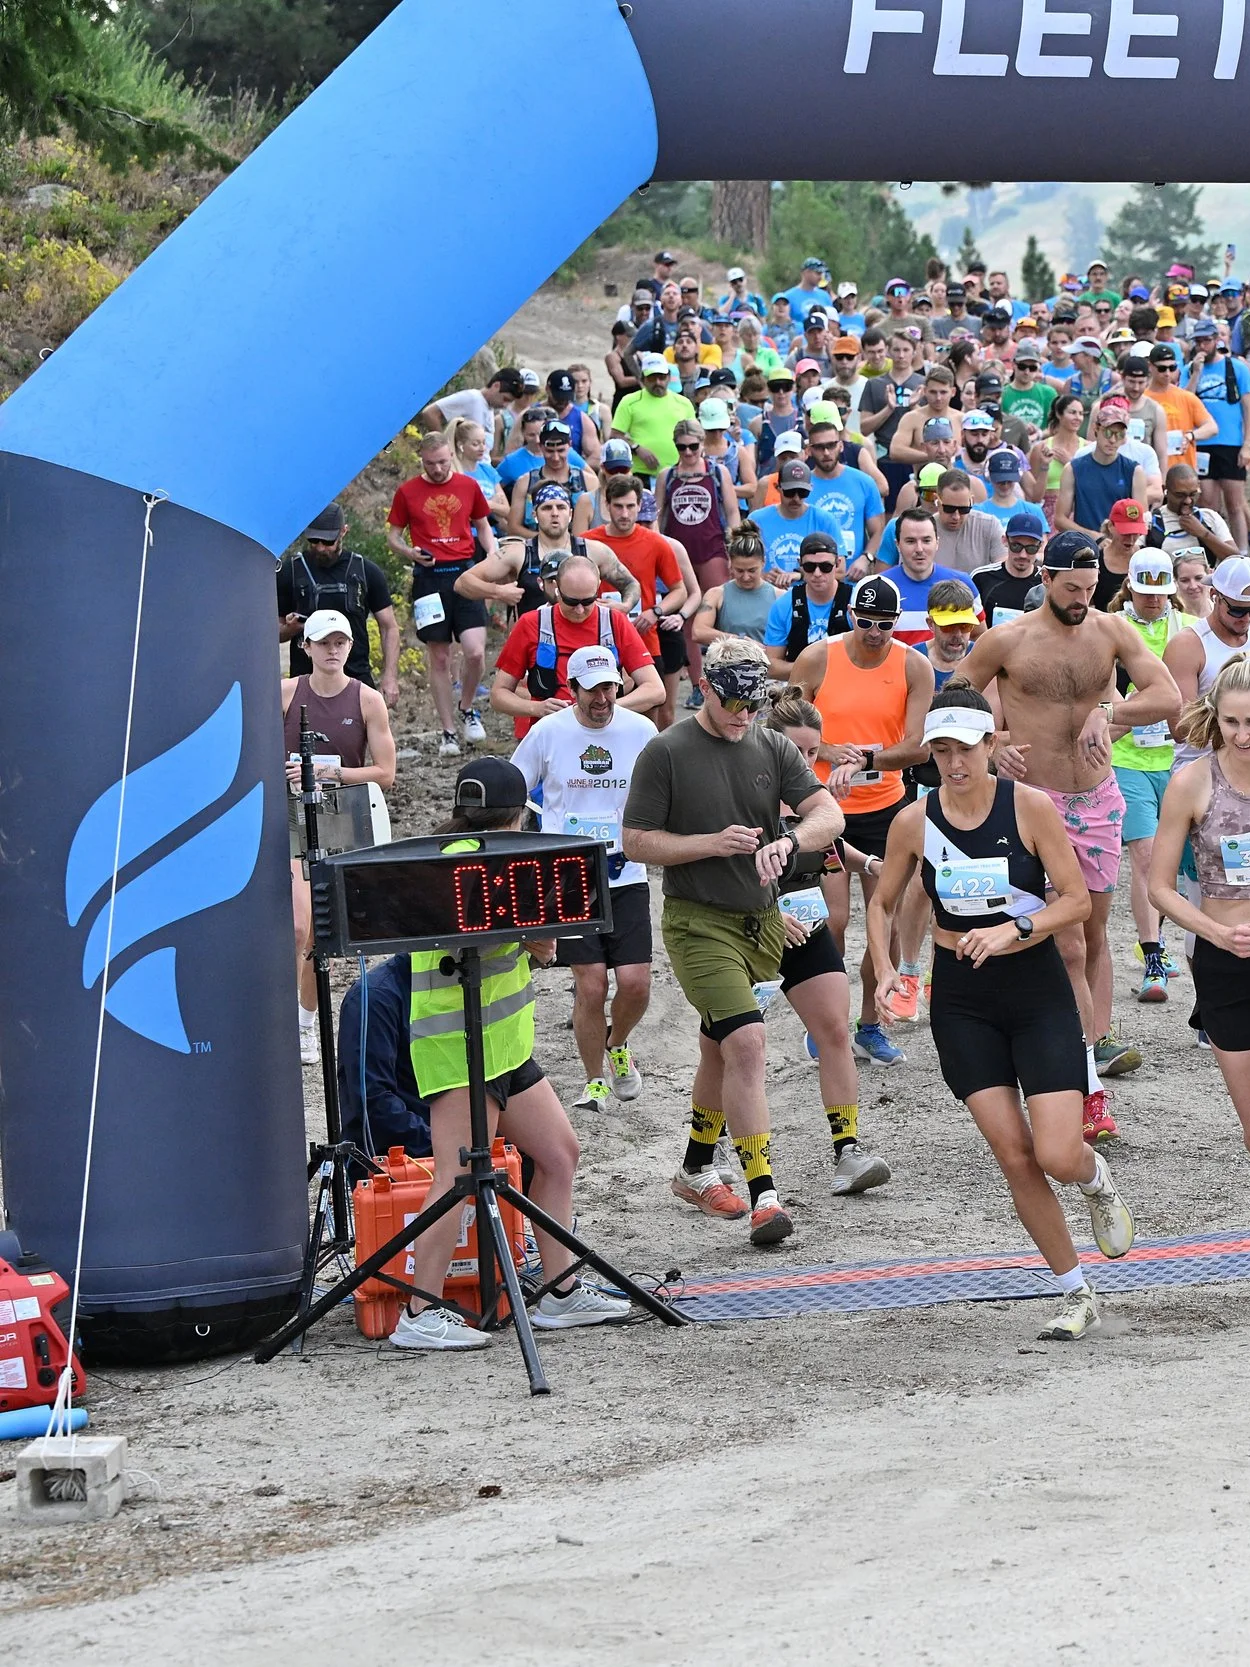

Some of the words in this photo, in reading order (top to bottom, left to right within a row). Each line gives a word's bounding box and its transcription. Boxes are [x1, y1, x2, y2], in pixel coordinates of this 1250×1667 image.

[594, 778, 627, 789] 2012
[576, 826, 610, 839] 446
[950, 876, 997, 897] 422
[454, 857, 590, 931] 0:00
[790, 904, 820, 920] 326
[192, 1041, 212, 1054] TM
